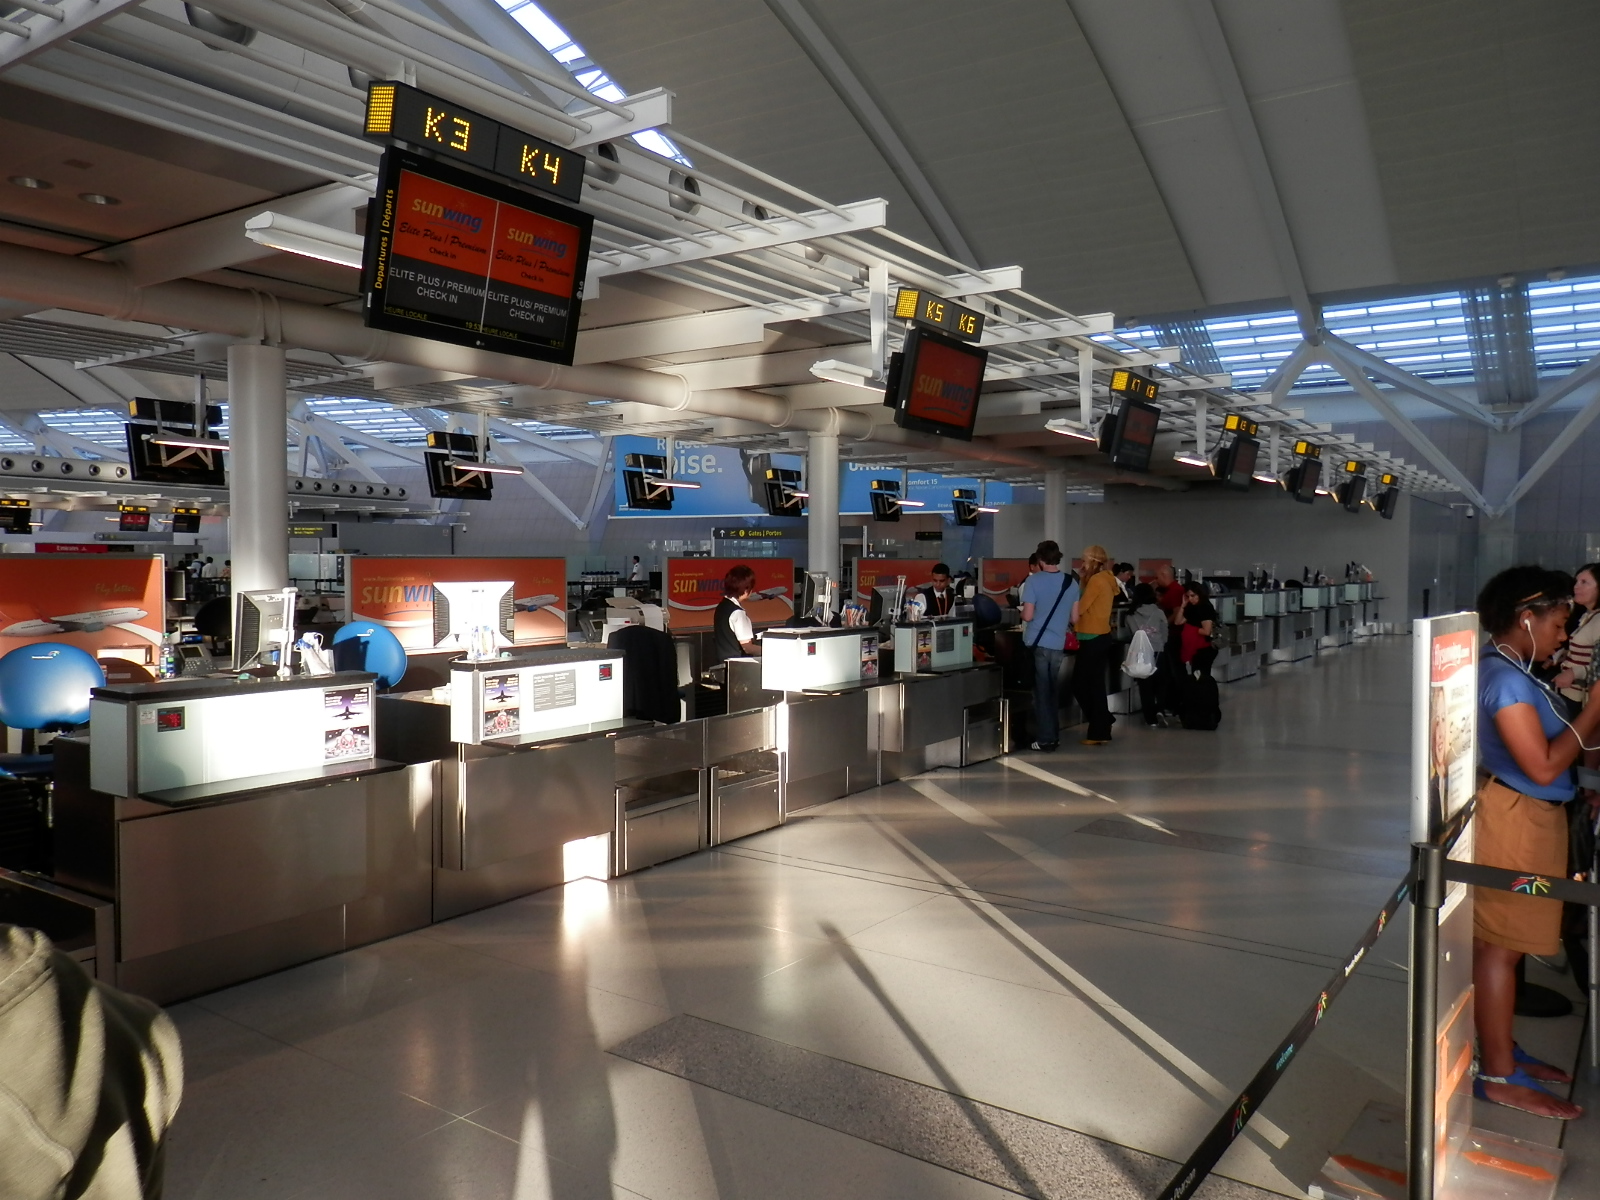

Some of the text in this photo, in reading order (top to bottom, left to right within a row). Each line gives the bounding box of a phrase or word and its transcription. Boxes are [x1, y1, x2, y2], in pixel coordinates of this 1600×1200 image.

[424, 107, 470, 151] K3
[520, 144, 560, 184] K4
[412, 198, 483, 233] sunwing
[375, 236, 388, 289] Departures
[382, 189, 394, 227] Départs
[399, 222, 420, 236] Elite
[423, 229, 442, 242] Plus
[450, 235, 487, 254] Premium
[429, 246, 448, 257] Check
[507, 227, 568, 259] sunwing
[495, 249, 513, 262] Elite
[515, 255, 532, 267] Plus
[539, 261, 570, 277] Premium
[389, 267, 415, 281] ELITE
[417, 274, 440, 287] PLUS
[446, 281, 485, 298] PREMIUM
[416, 286, 458, 304] CHECK IN
[487, 291, 509, 304] ELITE
[533, 303, 567, 317] PREMIUM
[509, 308, 545, 324] CHECK IN
[926, 300, 943, 322] K5
[958, 313, 976, 334] K6
[917, 374, 974, 411] sunwing
